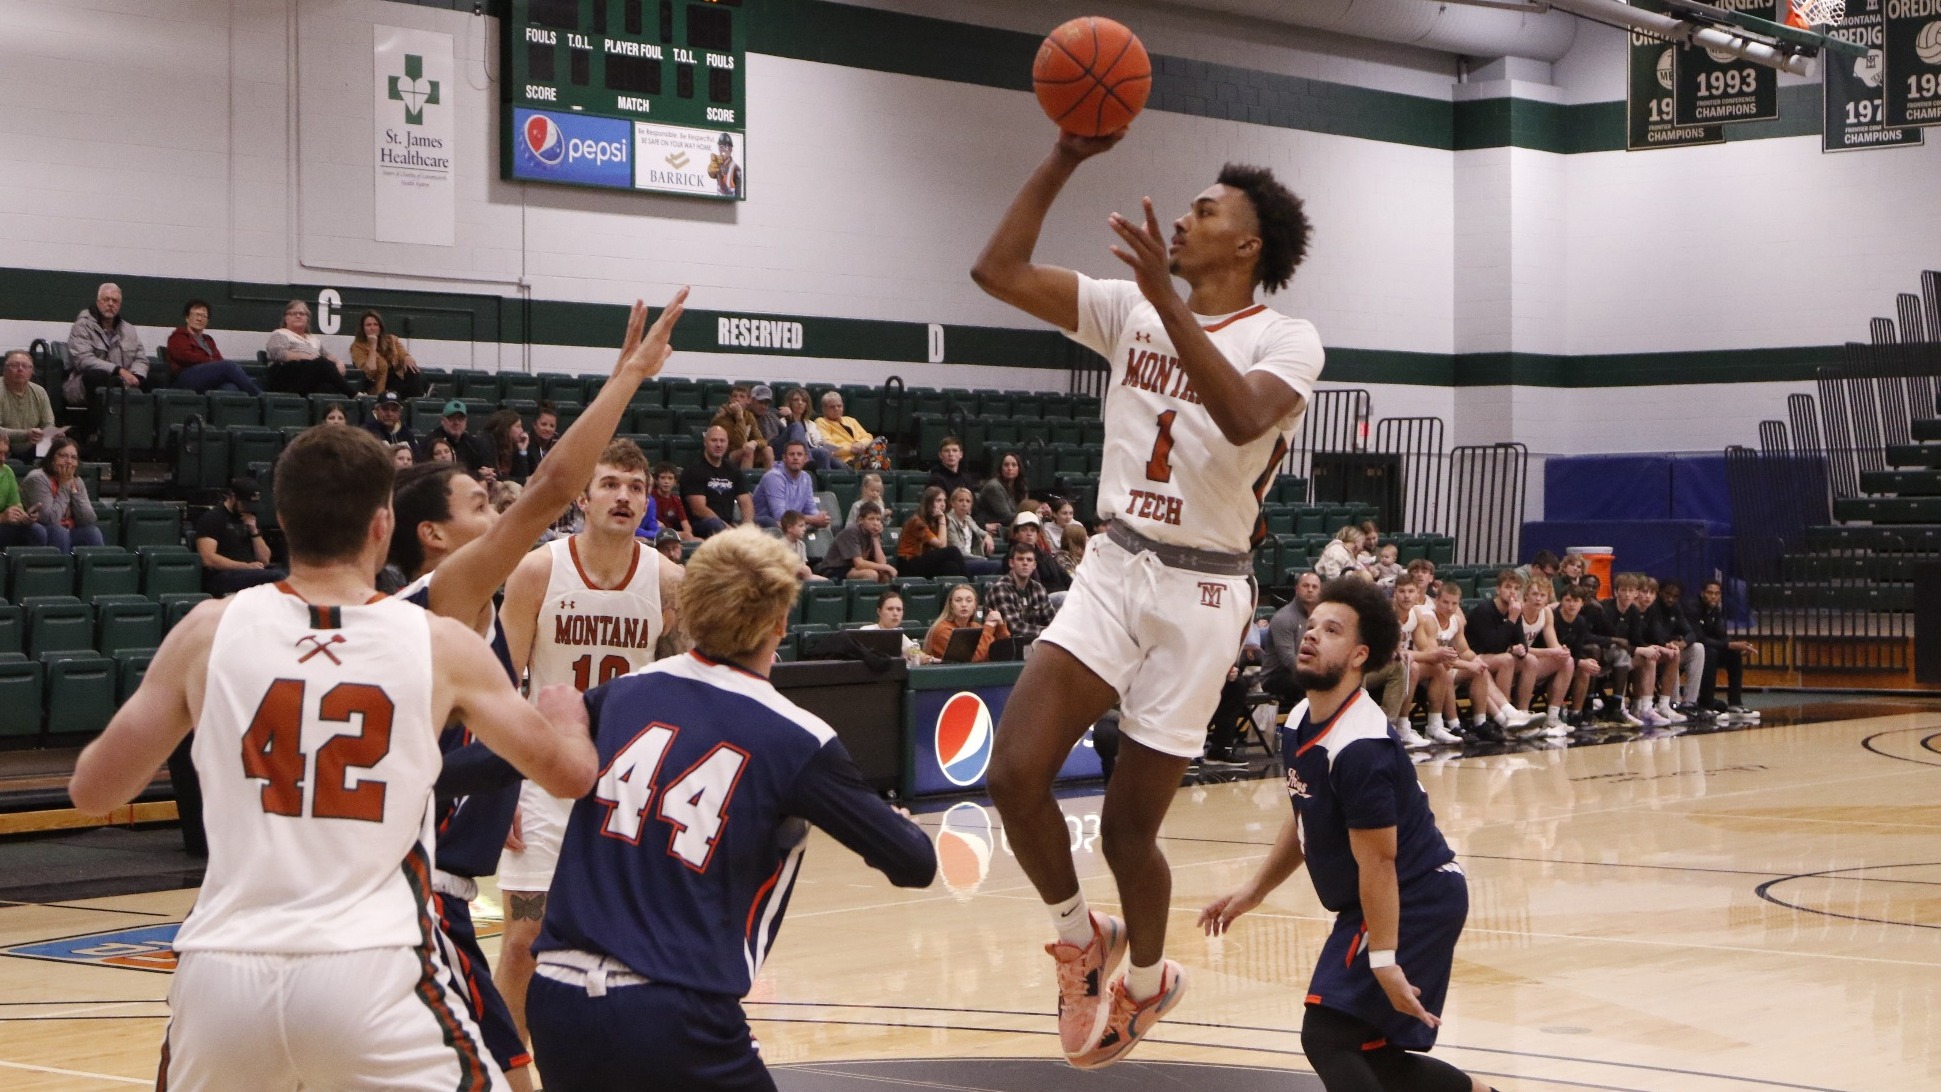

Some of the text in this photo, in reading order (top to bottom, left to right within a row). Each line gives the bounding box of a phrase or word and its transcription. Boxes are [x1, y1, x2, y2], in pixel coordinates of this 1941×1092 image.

[525, 27, 557, 45] FOULS
[567, 33, 594, 50] T.O.L.
[604, 39, 663, 60] PLAYER FOUL
[673, 47, 697, 64] T.O.L.
[706, 53, 734, 69] FOULS
[525, 85, 557, 101] SCORE
[1696, 68, 1757, 97] 1993
[1907, 73, 1941, 99] 19
[617, 95, 650, 112] MATCH
[1695, 103, 1757, 118] CHAMPIONS
[1845, 99, 1882, 124] 197
[1906, 107, 1941, 120] CHAMP
[706, 107, 734, 123] SCORE
[385, 128, 443, 149] St. James
[1647, 128, 1705, 142] CHAMPIONS
[1844, 129, 1903, 144] CHAMPIONS
[381, 148, 449, 168] Healthcare
[569, 138, 627, 165] pepsi
[650, 169, 705, 187] BARRICK
[318, 288, 342, 335] C
[717, 317, 803, 350] RESERVED
[928, 323, 944, 363] D
[1121, 347, 1202, 404] MONT
[1145, 409, 1177, 483] 1
[1126, 489, 1183, 526] TECH
[554, 614, 649, 649] MONTANA
[241, 677, 395, 823] 42
[594, 720, 751, 875] 44
